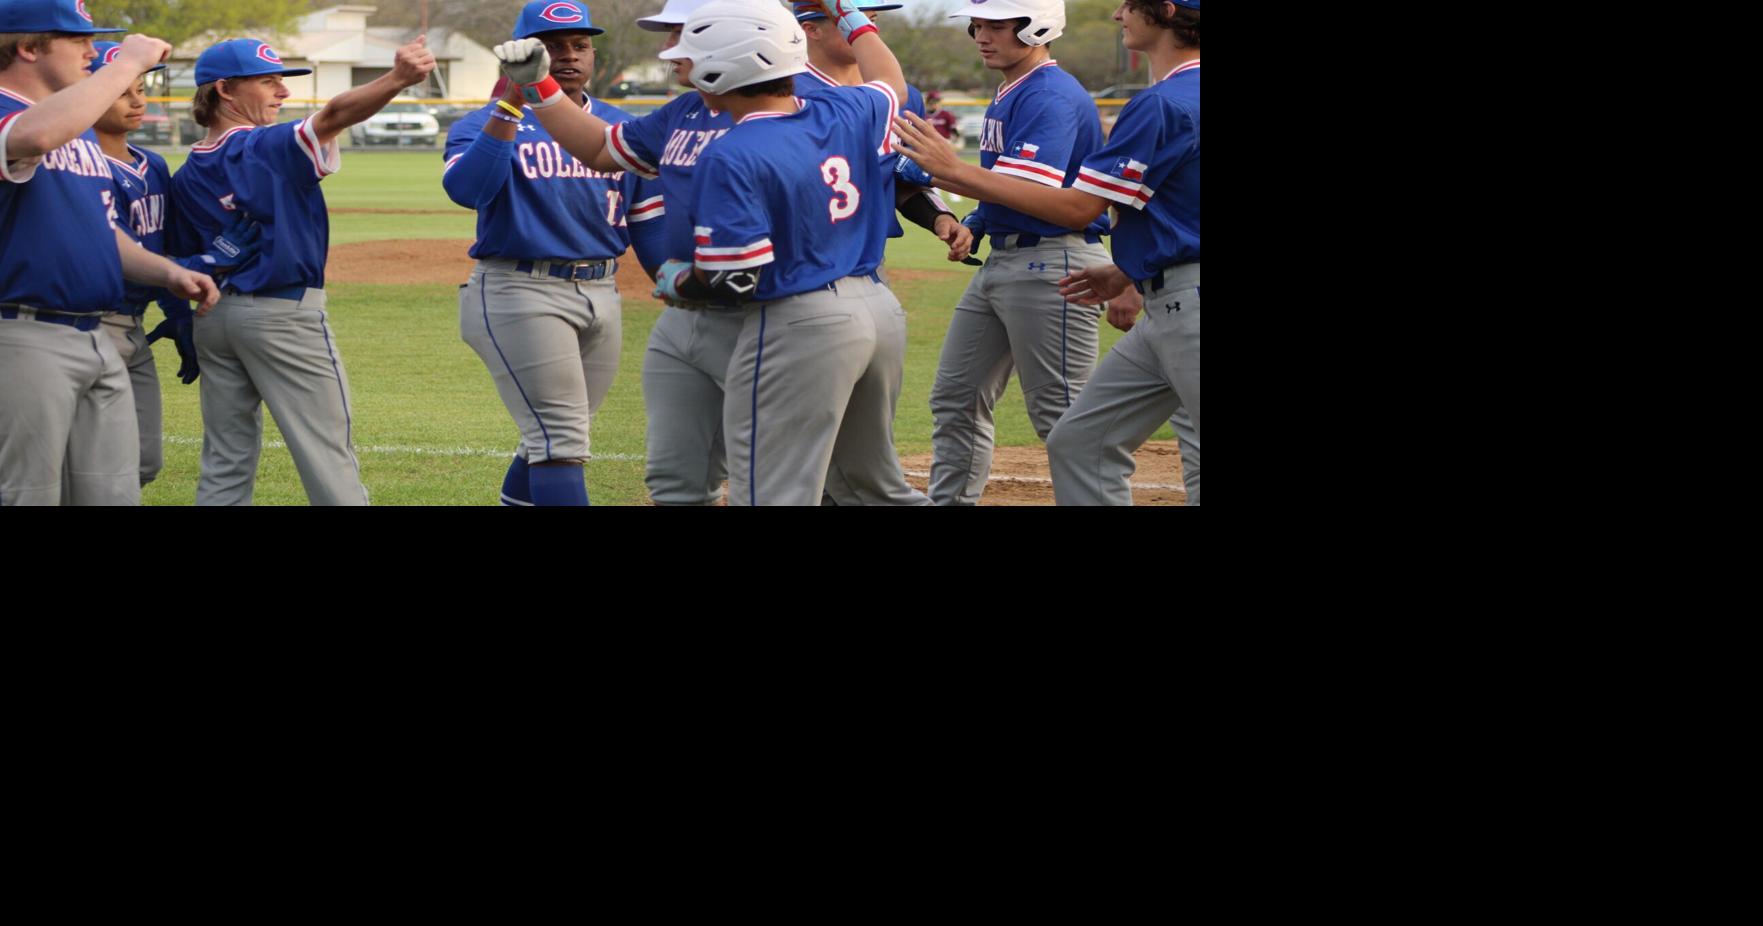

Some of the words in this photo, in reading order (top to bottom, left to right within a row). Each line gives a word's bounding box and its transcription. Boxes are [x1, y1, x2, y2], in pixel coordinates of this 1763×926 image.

[538, 2, 583, 23] C
[256, 43, 283, 64] C
[518, 140, 625, 181] COLE
[819, 154, 862, 224] 3
